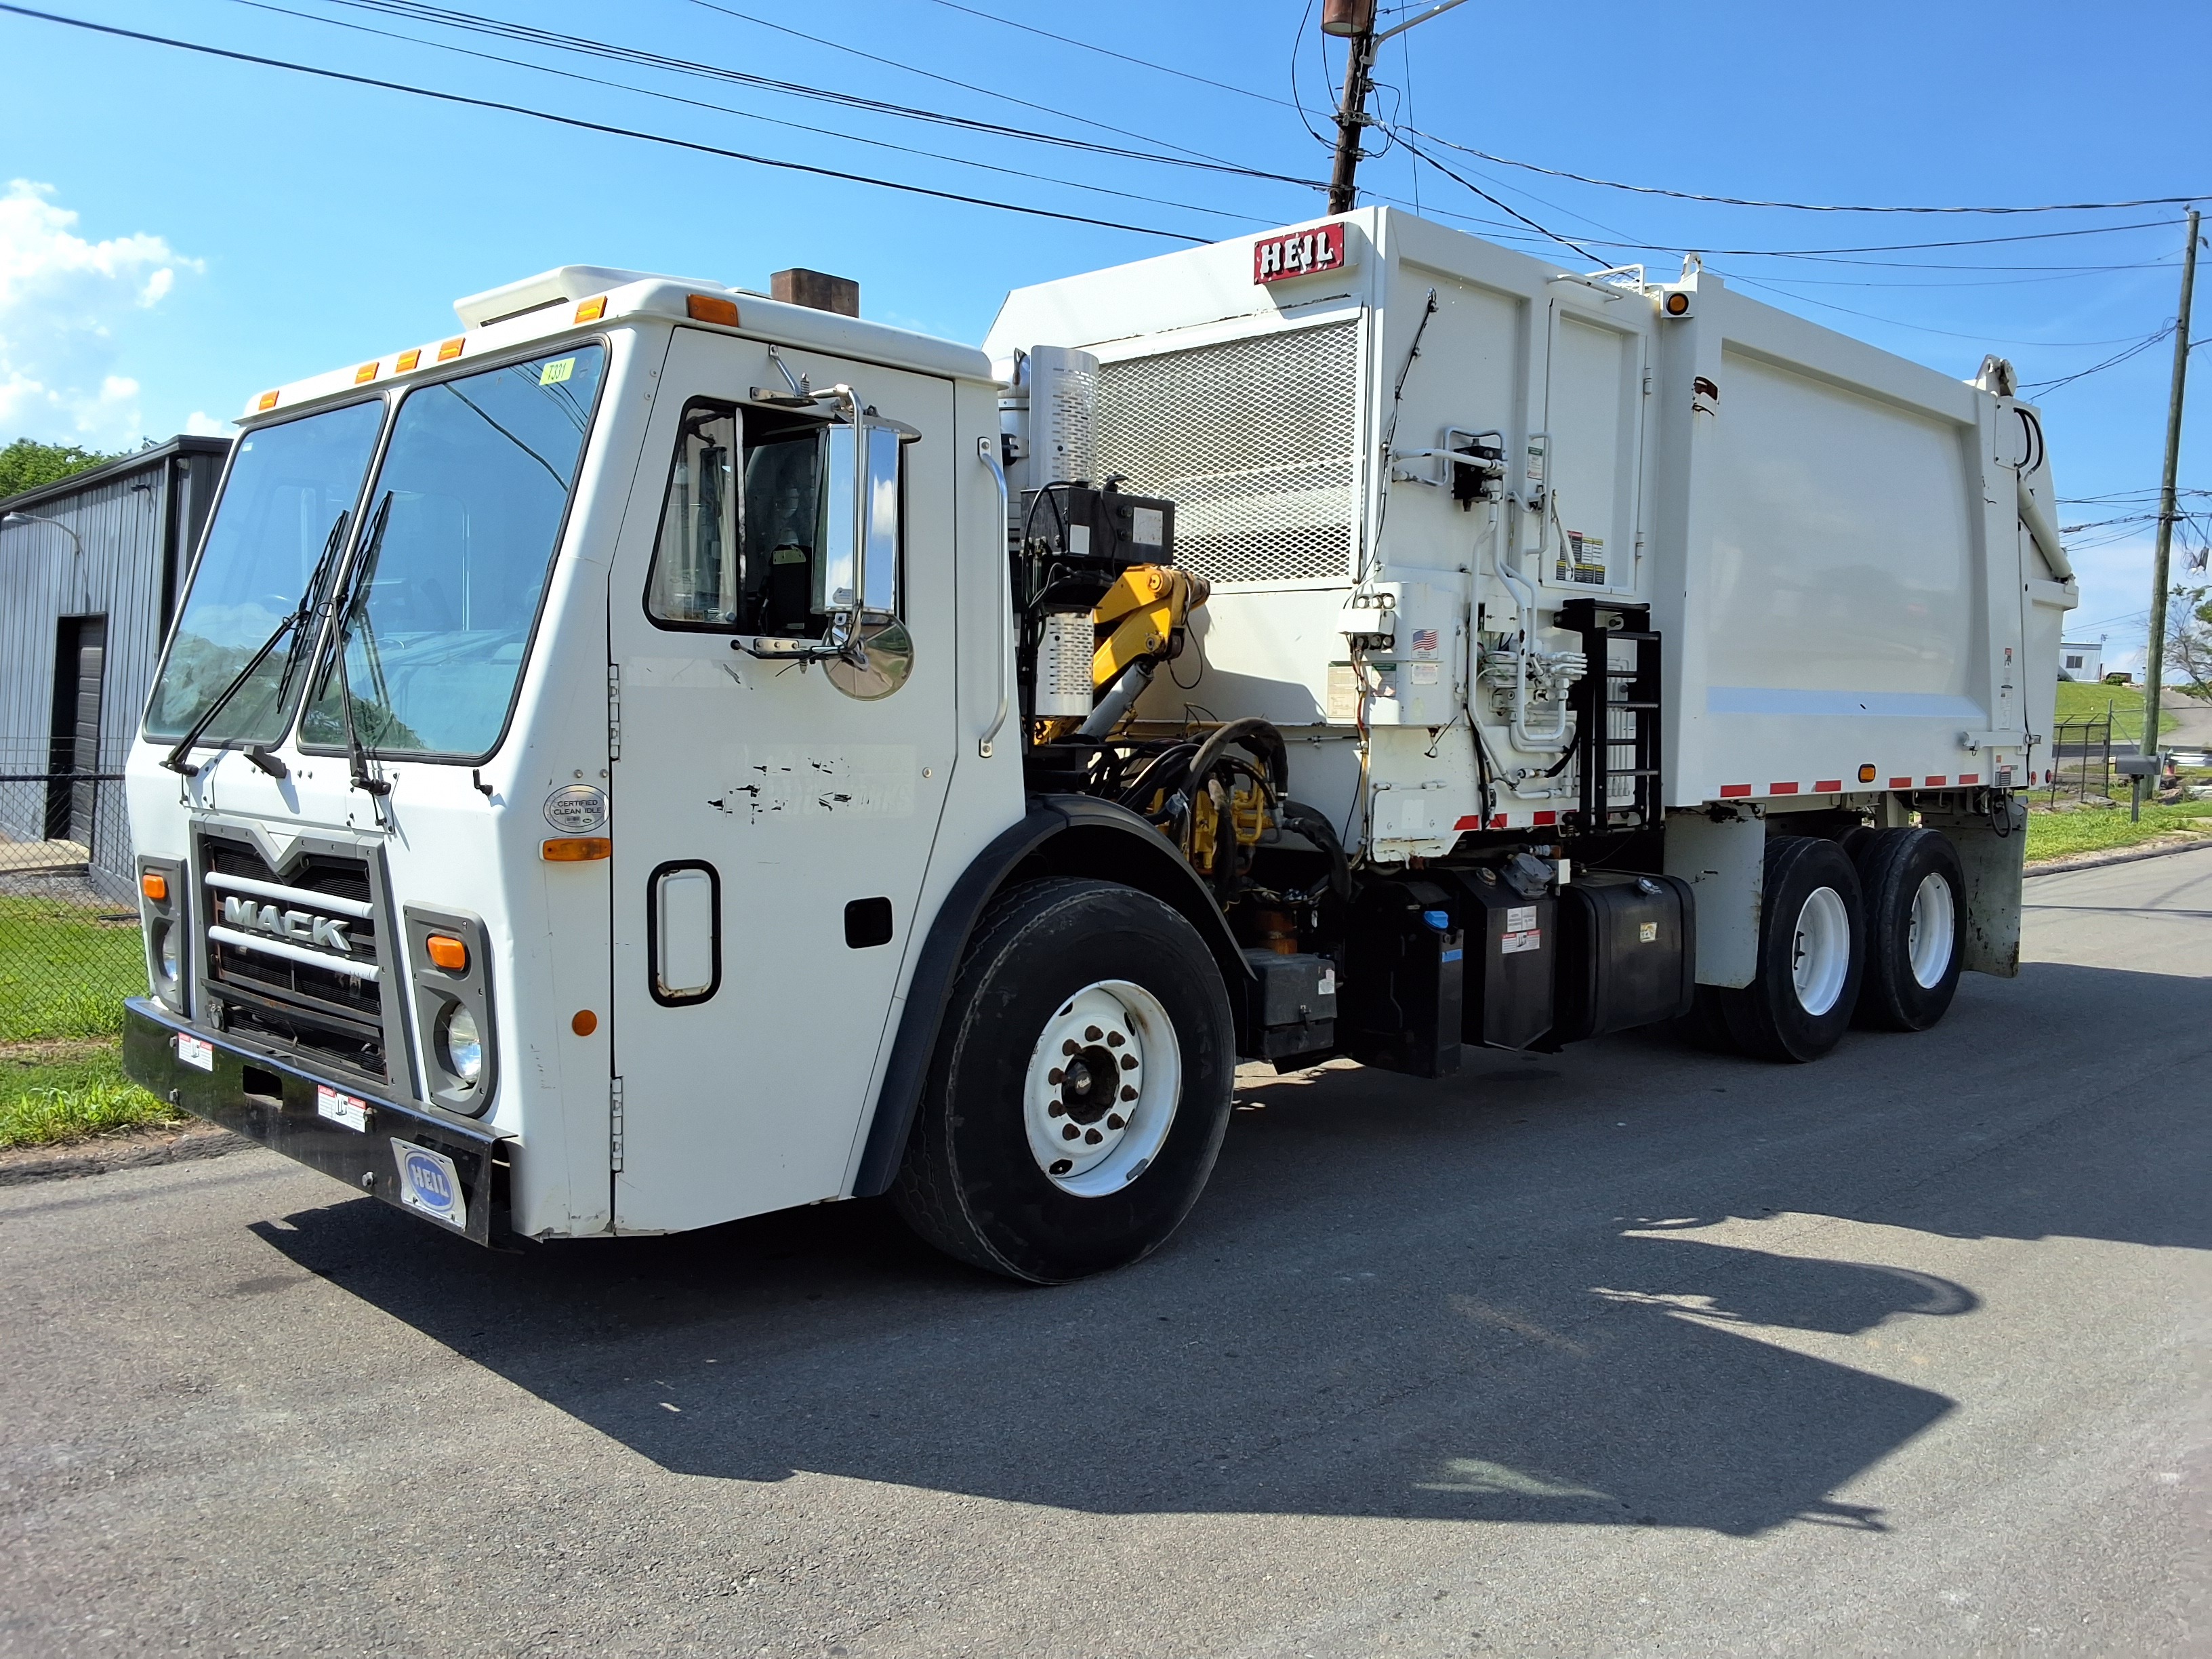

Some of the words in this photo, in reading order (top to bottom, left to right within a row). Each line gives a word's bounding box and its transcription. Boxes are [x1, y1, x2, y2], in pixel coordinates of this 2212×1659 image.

[1260, 231, 1334, 274] HEIL
[548, 362, 567, 381] T331
[224, 896, 352, 951] MACK
[411, 1164, 449, 1198] HEIL
